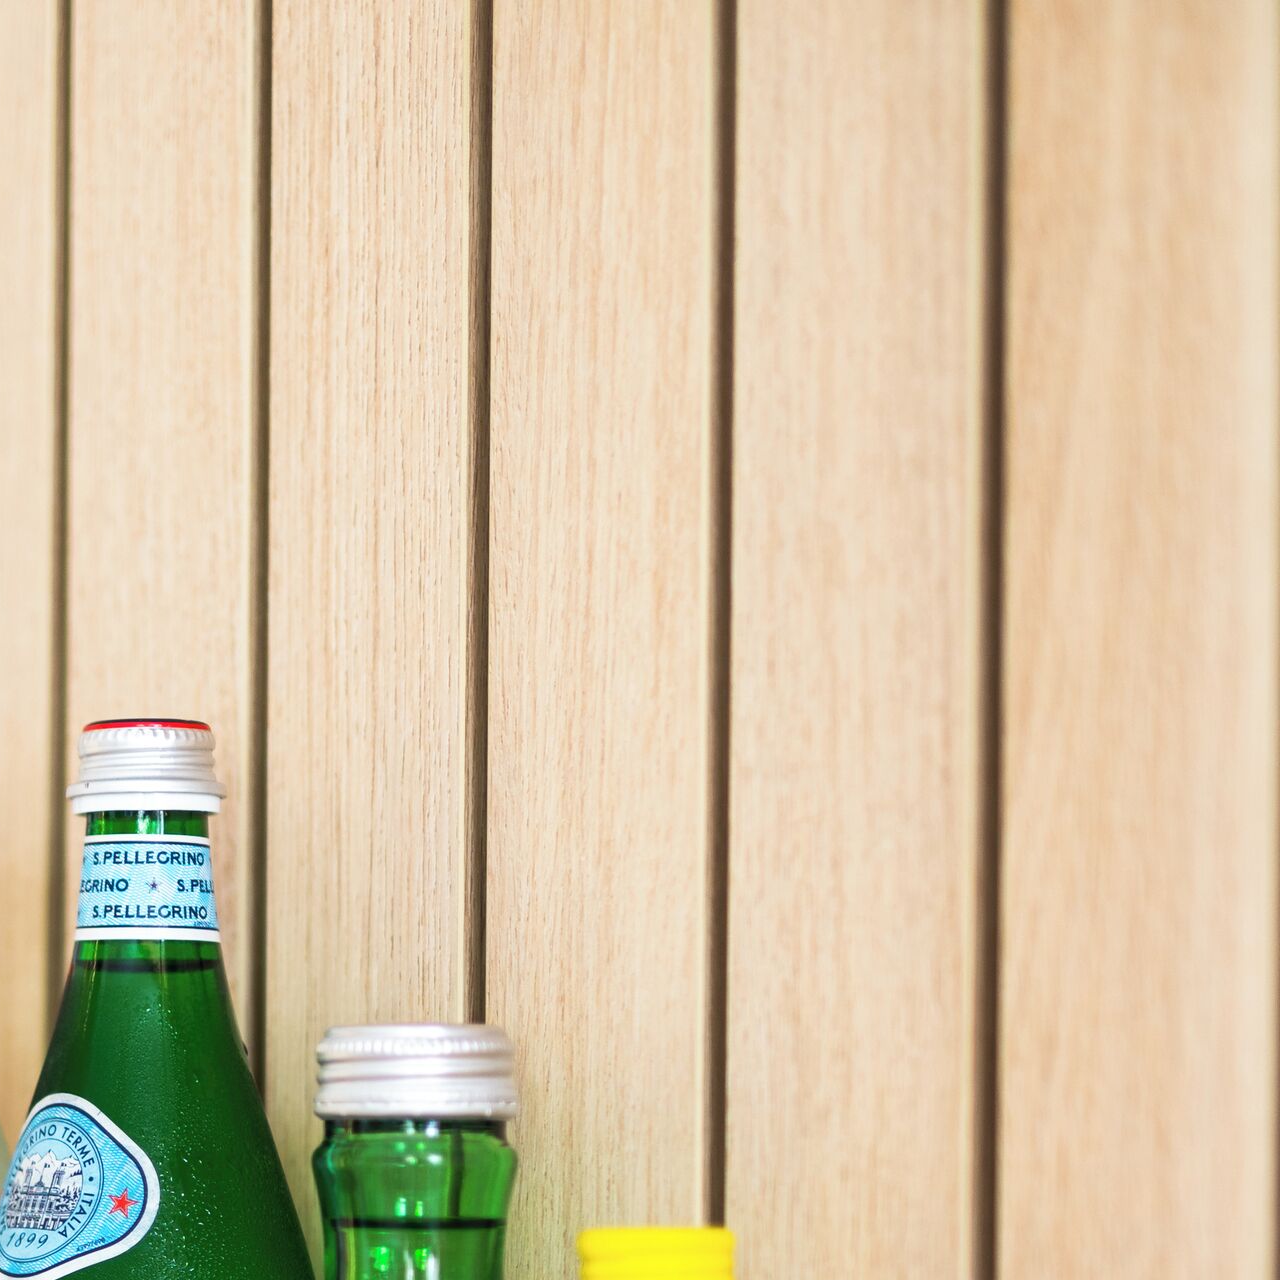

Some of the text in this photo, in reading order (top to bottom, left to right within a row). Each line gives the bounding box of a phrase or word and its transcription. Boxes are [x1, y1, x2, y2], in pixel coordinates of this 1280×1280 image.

[63, 1127, 95, 1168] TERME
[58, 1193, 95, 1238] ITALIA
[6, 1232, 49, 1249] 1899
